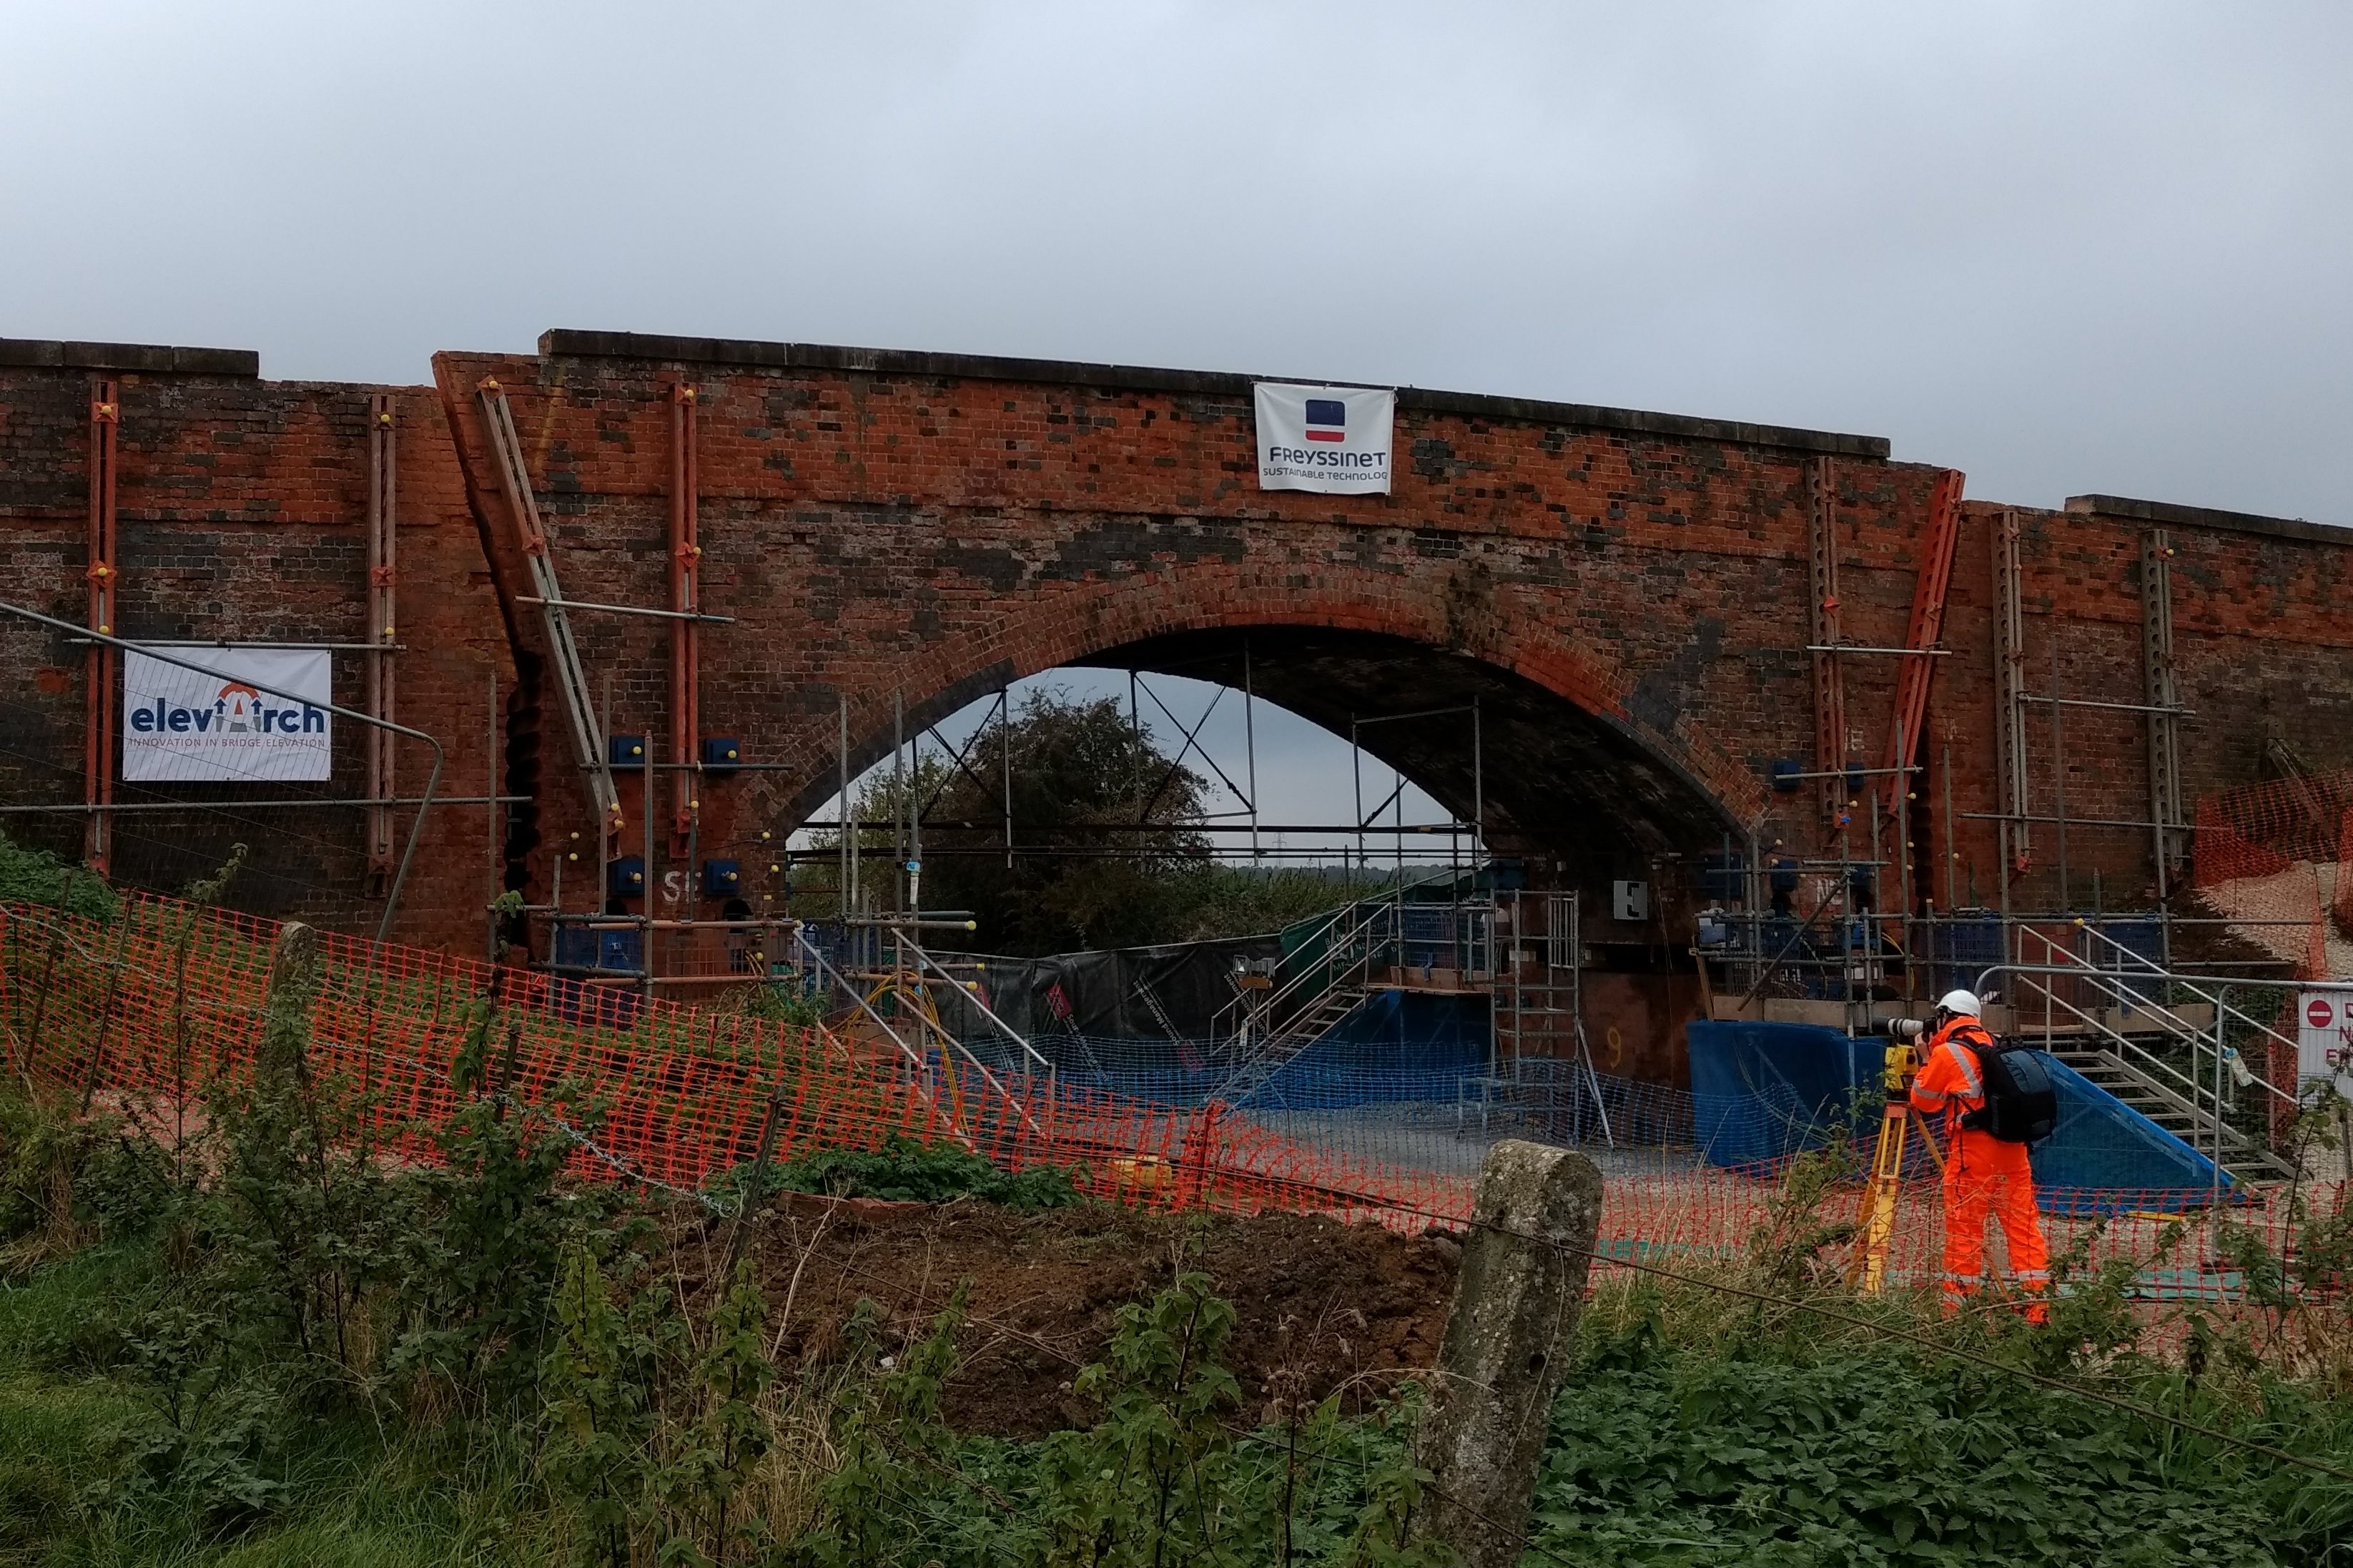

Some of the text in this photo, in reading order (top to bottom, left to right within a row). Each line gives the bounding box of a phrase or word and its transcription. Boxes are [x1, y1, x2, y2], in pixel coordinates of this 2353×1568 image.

[129, 738, 201, 746] INNOVATION
[266, 739, 325, 747] ELEVATION
[1133, 980, 1165, 1025] Management
